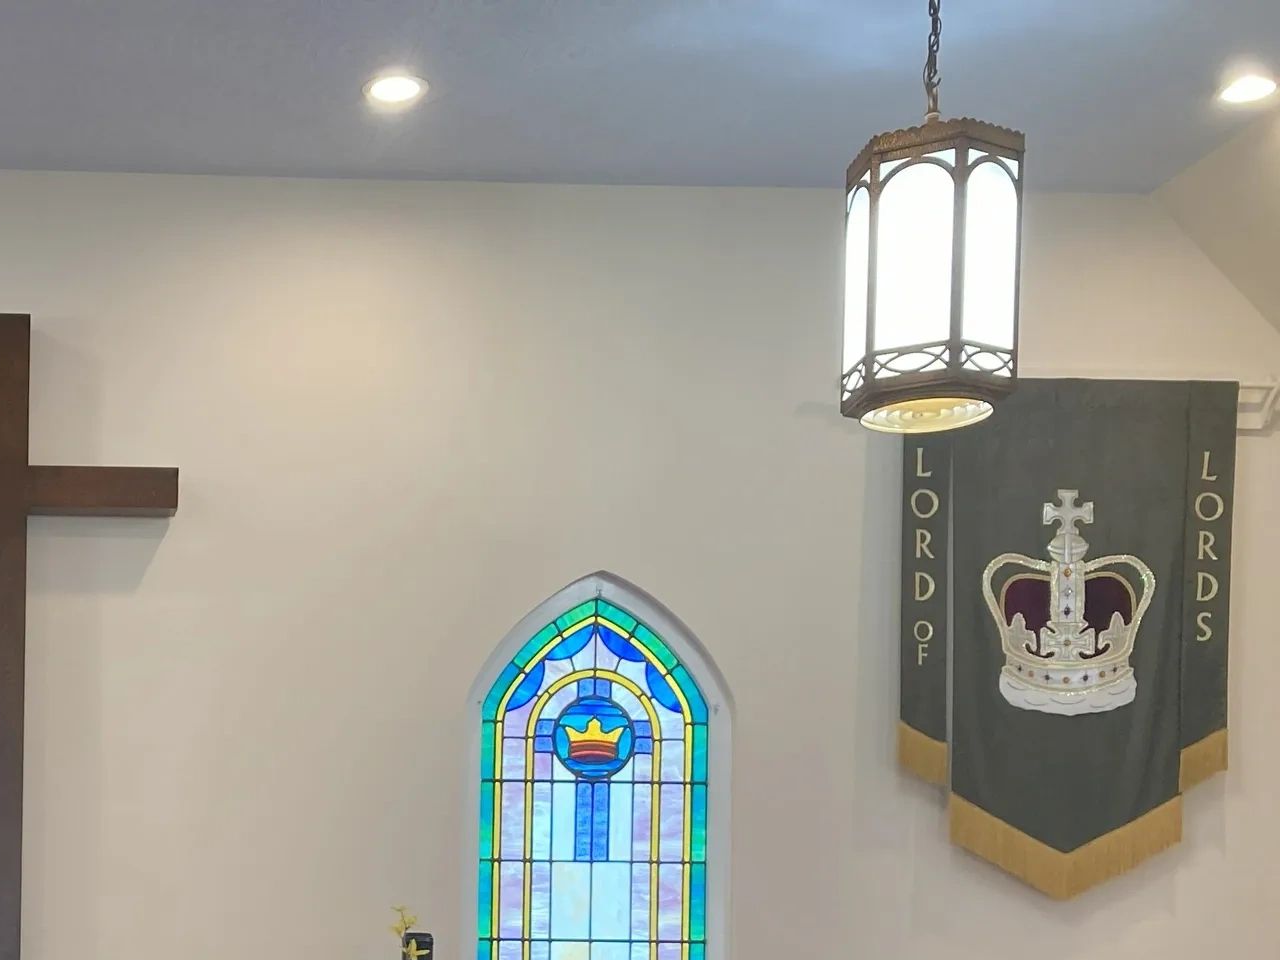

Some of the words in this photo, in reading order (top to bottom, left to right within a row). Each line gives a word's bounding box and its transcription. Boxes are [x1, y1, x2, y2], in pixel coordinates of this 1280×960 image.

[910, 447, 939, 601] LORD
[1194, 451, 1224, 642] LORDS
[914, 620, 934, 666] OF
